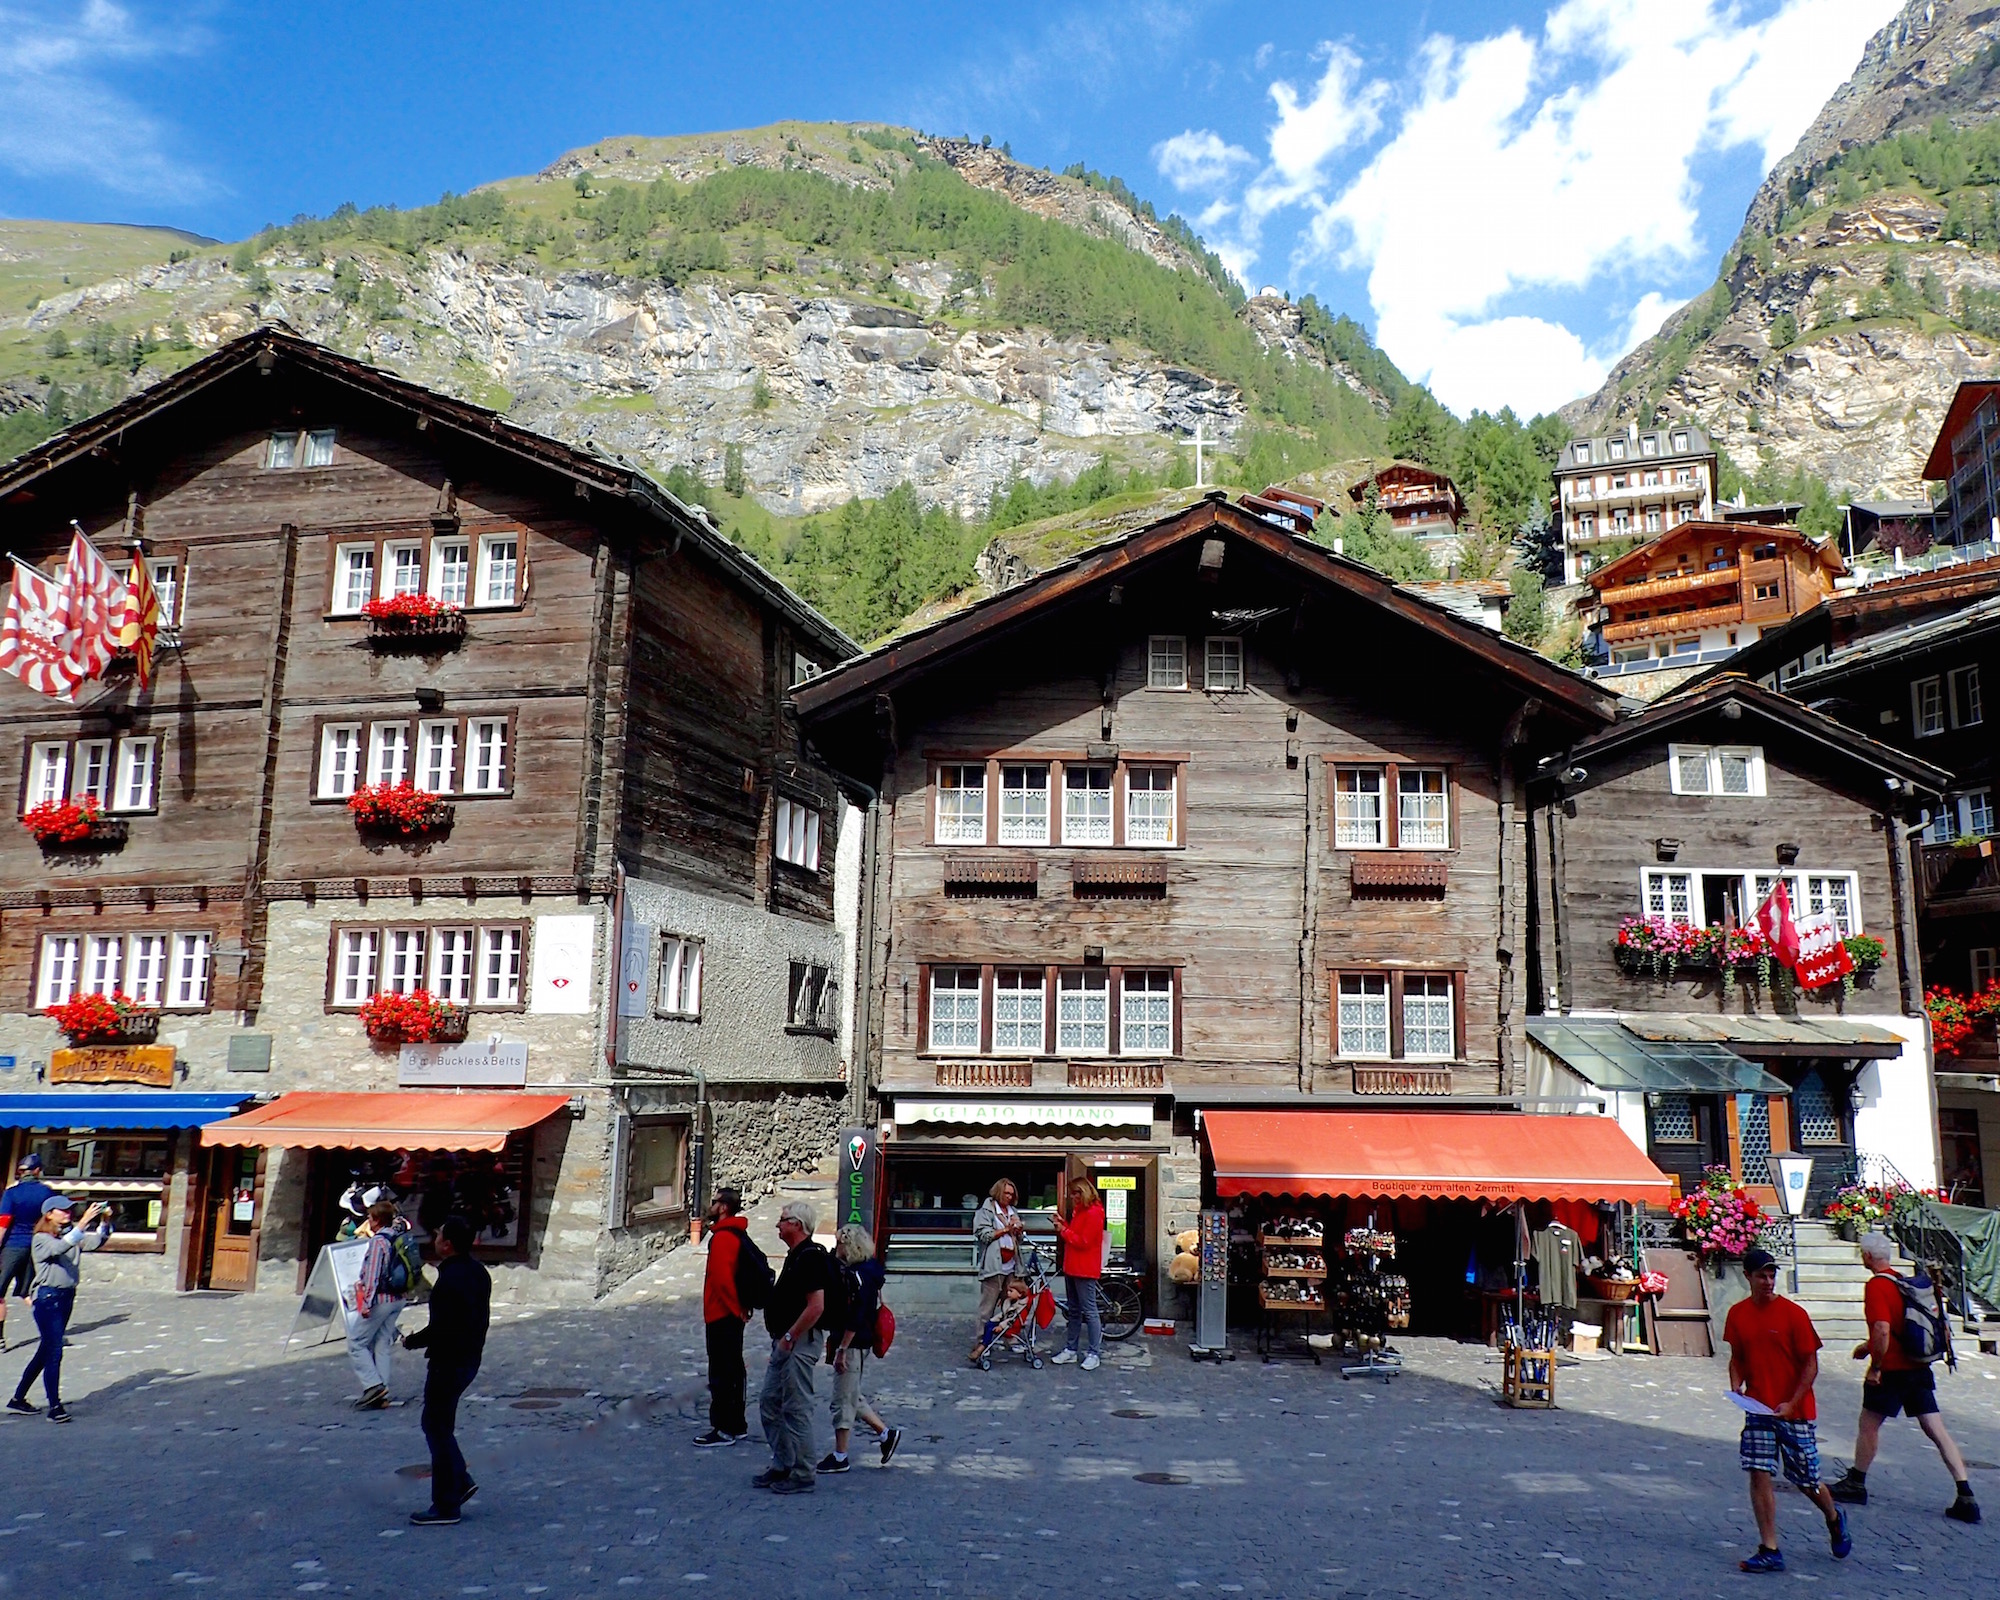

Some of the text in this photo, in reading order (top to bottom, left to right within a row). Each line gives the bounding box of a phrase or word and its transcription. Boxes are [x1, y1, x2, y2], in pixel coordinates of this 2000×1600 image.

[932, 1106, 1115, 1120] GELATO ITALIANO
[1372, 1181, 1515, 1193] Boutique zum alten Zermatt
